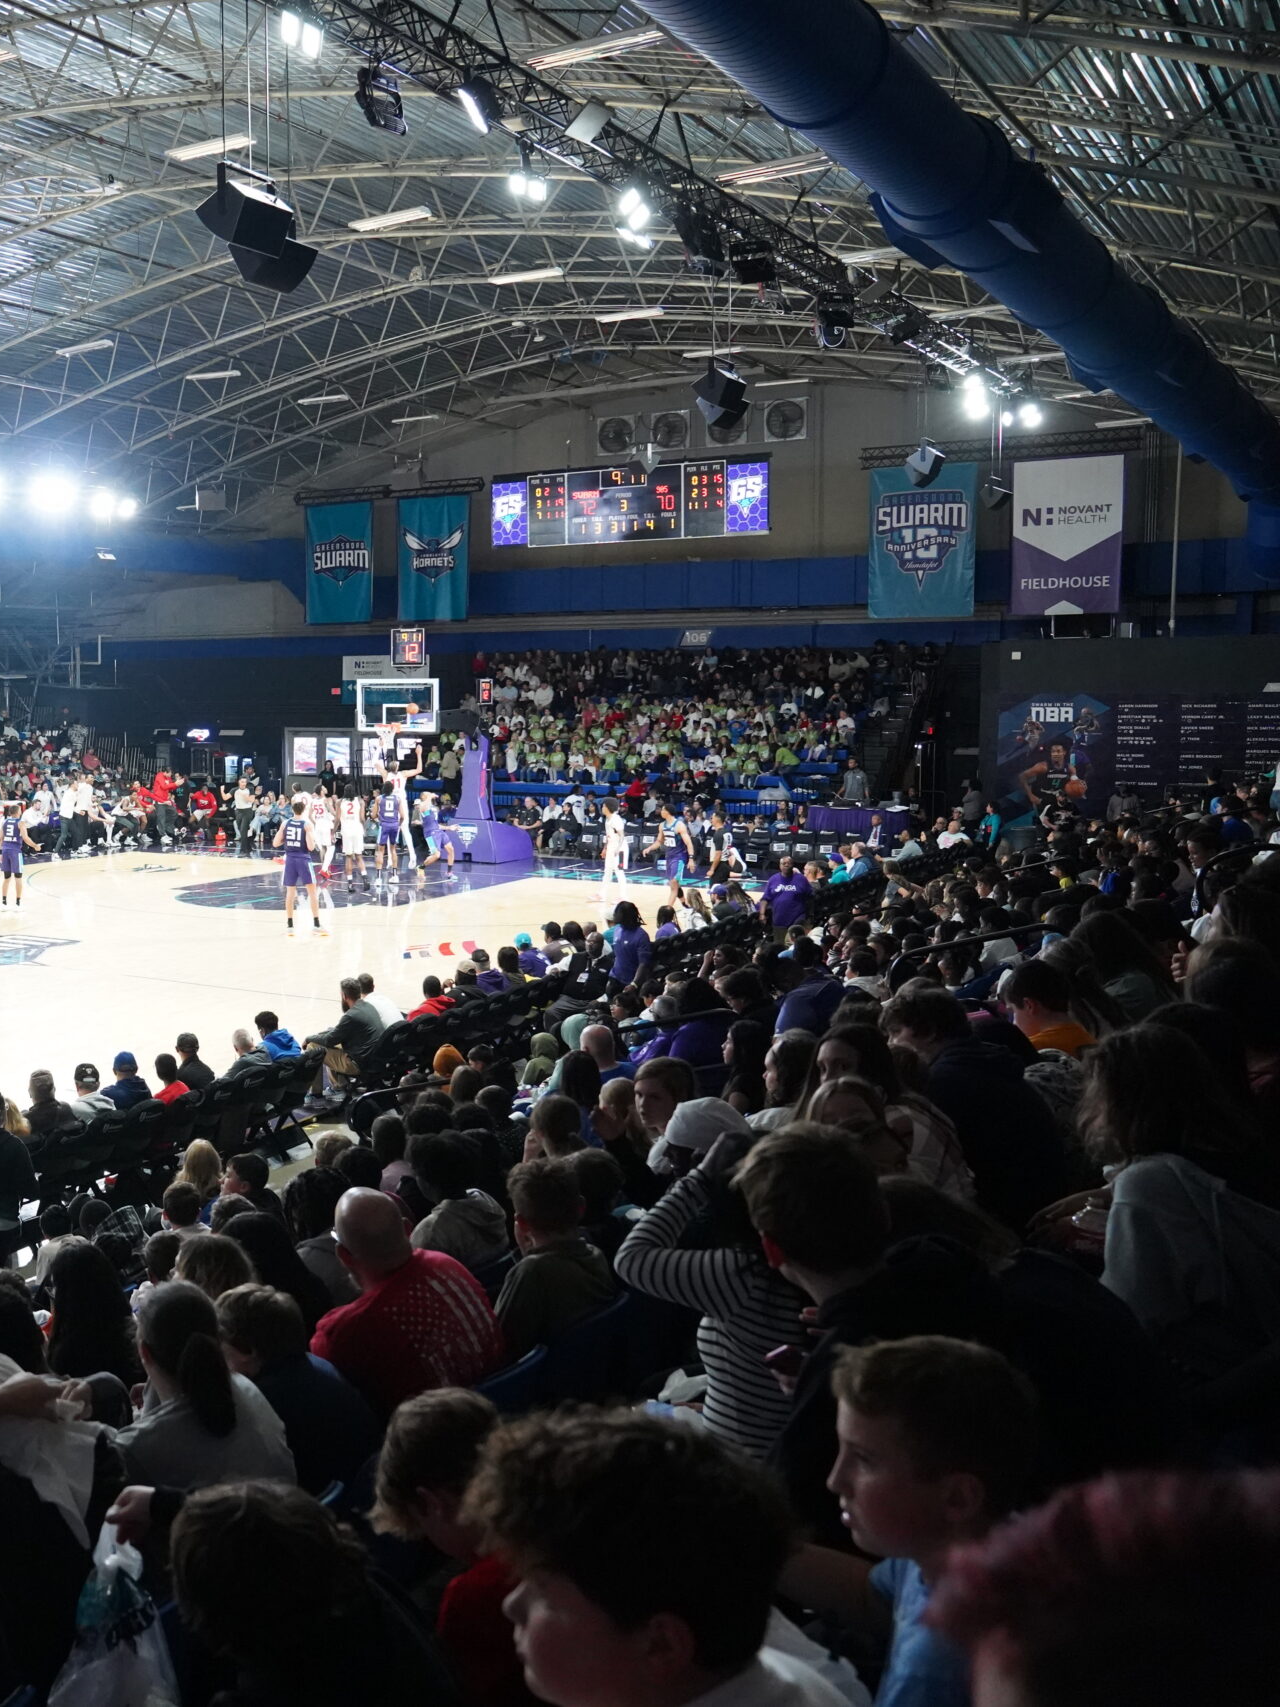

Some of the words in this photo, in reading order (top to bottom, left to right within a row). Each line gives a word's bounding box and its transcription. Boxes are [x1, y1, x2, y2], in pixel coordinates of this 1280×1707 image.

[612, 471, 644, 485] 9:11
[691, 475, 698, 485] 0
[702, 475, 708, 484] 3
[714, 474, 723, 483] 15
[535, 487, 542, 497] 0
[544, 487, 550, 496] 2
[572, 490, 600, 500] SWARM
[691, 488, 698, 498] 2
[702, 488, 708, 497] 3
[717, 487, 723, 495] 4
[536, 500, 542, 509] 3
[555, 498, 564, 506] 19
[579, 500, 597, 515] 72
[620, 499, 627, 512] 3
[656, 494, 675, 510] 70
[689, 502, 698, 510] 11
[536, 511, 542, 519] 7
[1058, 503, 1113, 515] NOVANT
[877, 503, 966, 531] SWARM
[1058, 513, 1107, 525] HEALTH
[594, 522, 601, 534] 3
[645, 519, 654, 530] 4
[887, 536, 956, 551] ANNIVERSARY
[314, 550, 369, 571] SWARM
[413, 555, 454, 569] HORNETS
[1020, 575, 1110, 590] FIELDHOUSE
[685, 631, 708, 643] 106
[404, 643, 419, 662] 12
[1031, 706, 1074, 722] NBA
[314, 804, 324, 815] 55
[347, 803, 354, 815] 2
[385, 800, 394, 811] 0
[6, 824, 14, 836] 3
[286, 826, 302, 841] 31
